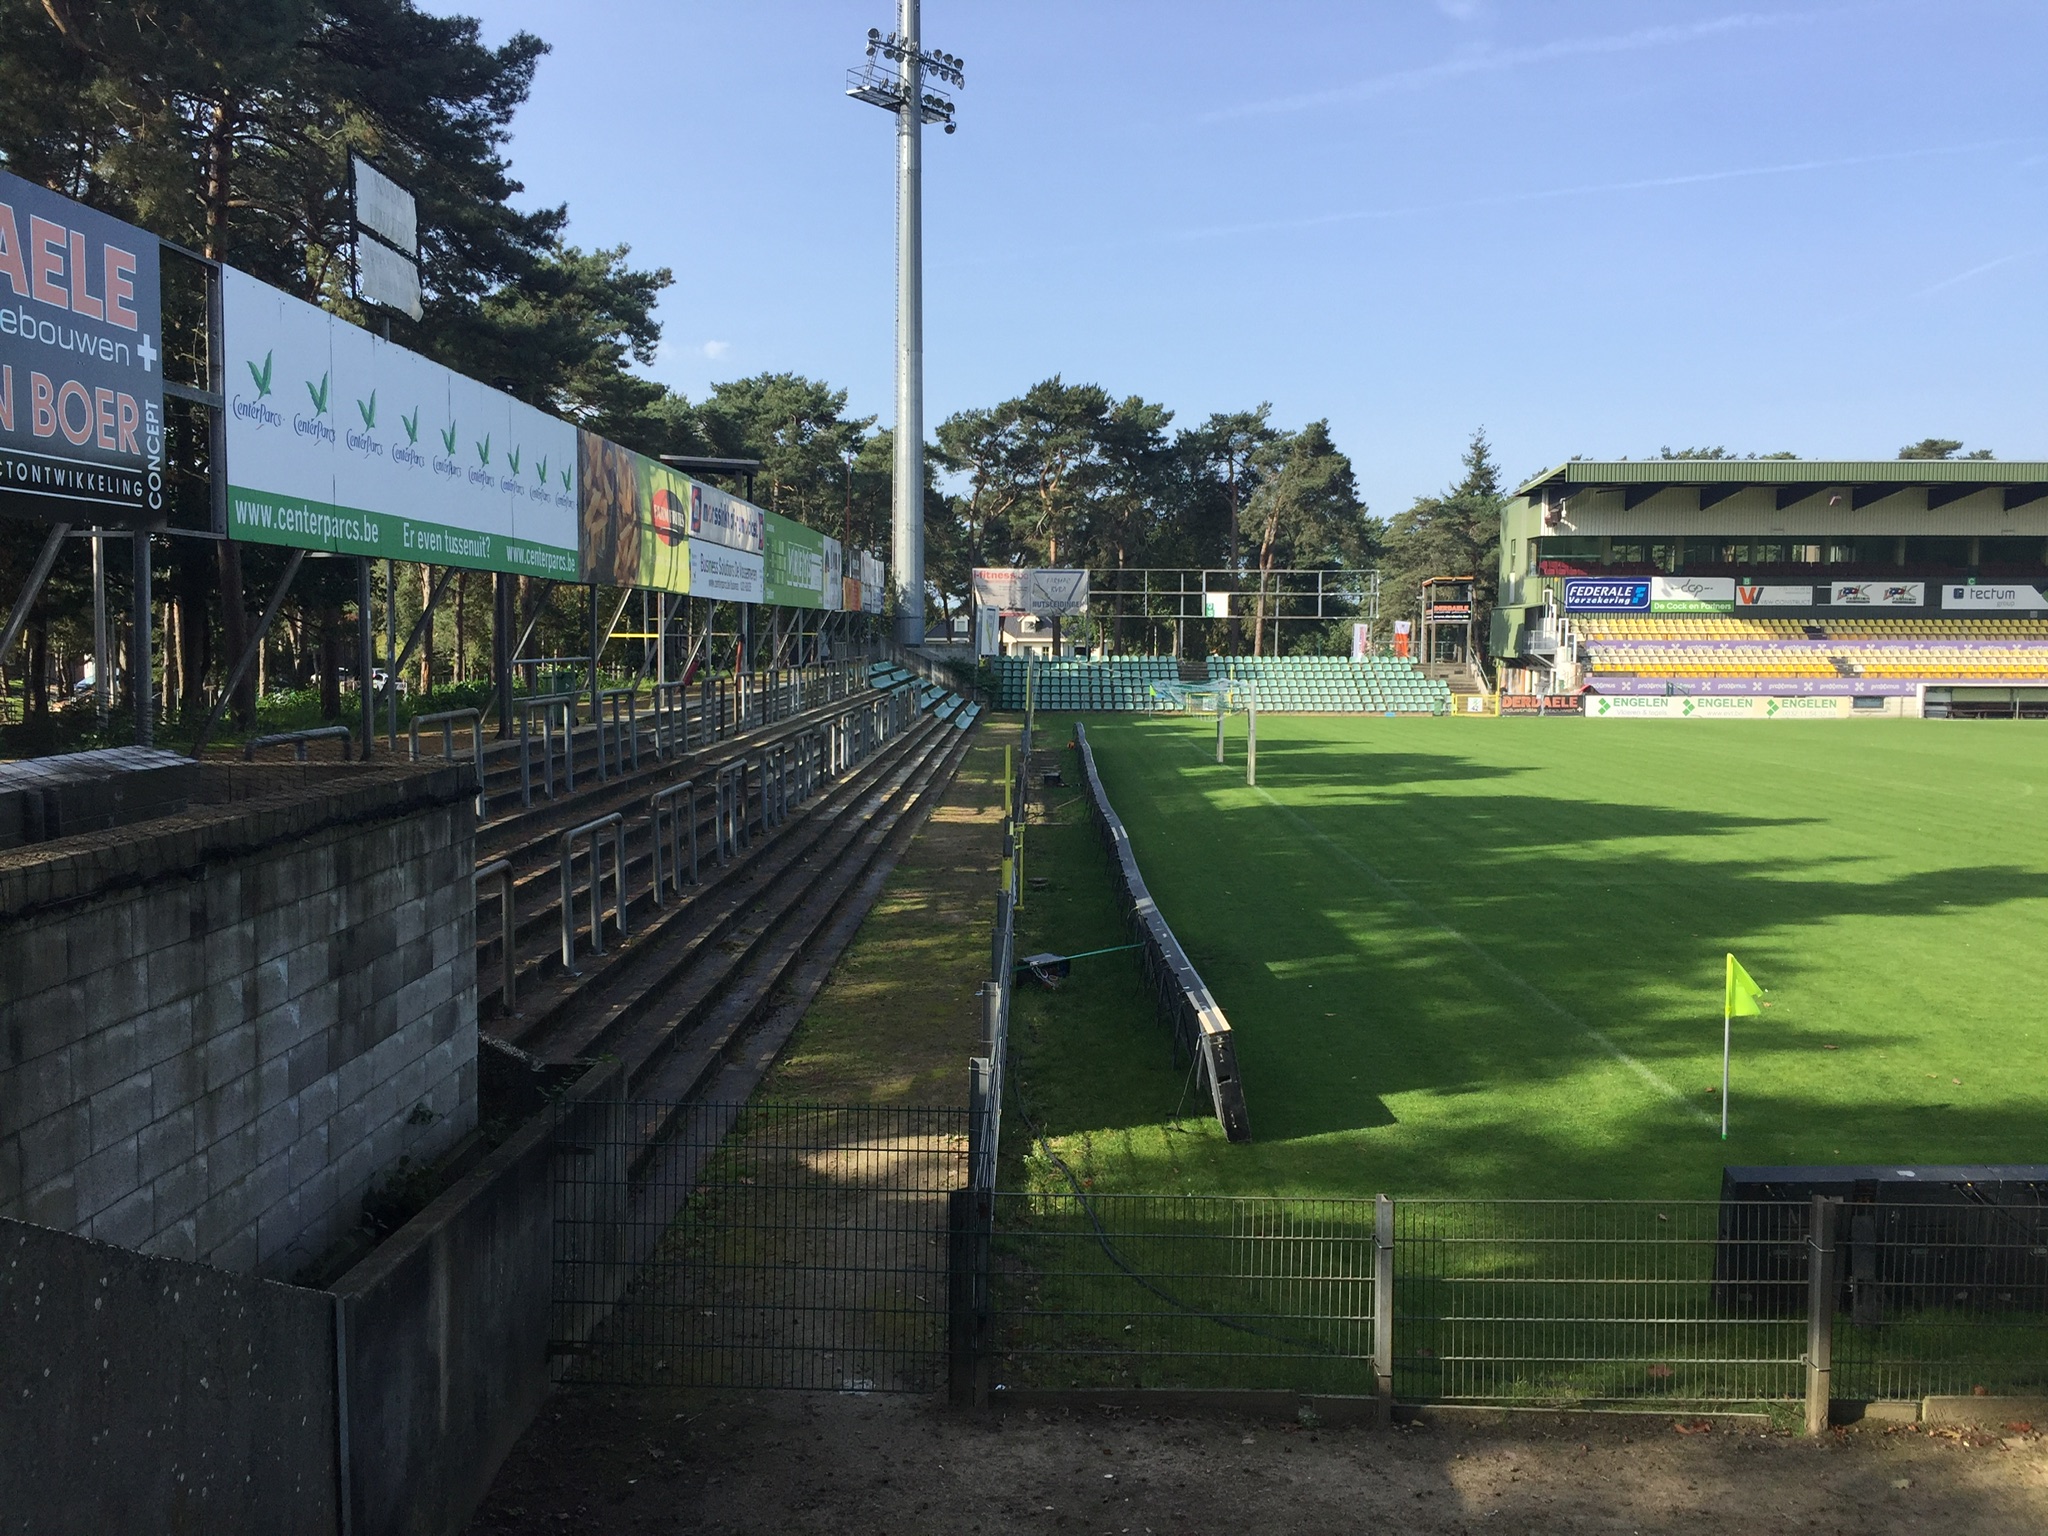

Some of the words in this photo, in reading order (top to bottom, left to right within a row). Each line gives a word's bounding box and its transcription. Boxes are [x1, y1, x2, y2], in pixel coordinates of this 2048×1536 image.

[30, 371, 141, 456] BOER
[145, 399, 162, 511] CONCEPT
[0, 460, 143, 498] TONTWIKKELING
[235, 500, 379, 543] www.centerparcs.be
[403, 522, 415, 547] Er
[417, 532, 443, 552] even
[444, 530, 491, 559] tussenuit?
[506, 545, 576, 572] www.centerparcs.be
[1569, 586, 1633, 597] FEDERALE
[1969, 587, 2016, 600] tectum
[1032, 600, 1083, 608] NUTSLEIDINGE
[1569, 596, 1631, 605] Verzekering
[1654, 602, 1665, 610] De
[1666, 602, 1688, 610] Cock
[1700, 602, 1731, 611] Partners
[1502, 696, 1578, 708] DERDAELE
[1613, 697, 1669, 707] ENGELEN
[1697, 698, 1753, 708] ENGELEN
[1781, 699, 1837, 708] ENGELEN
